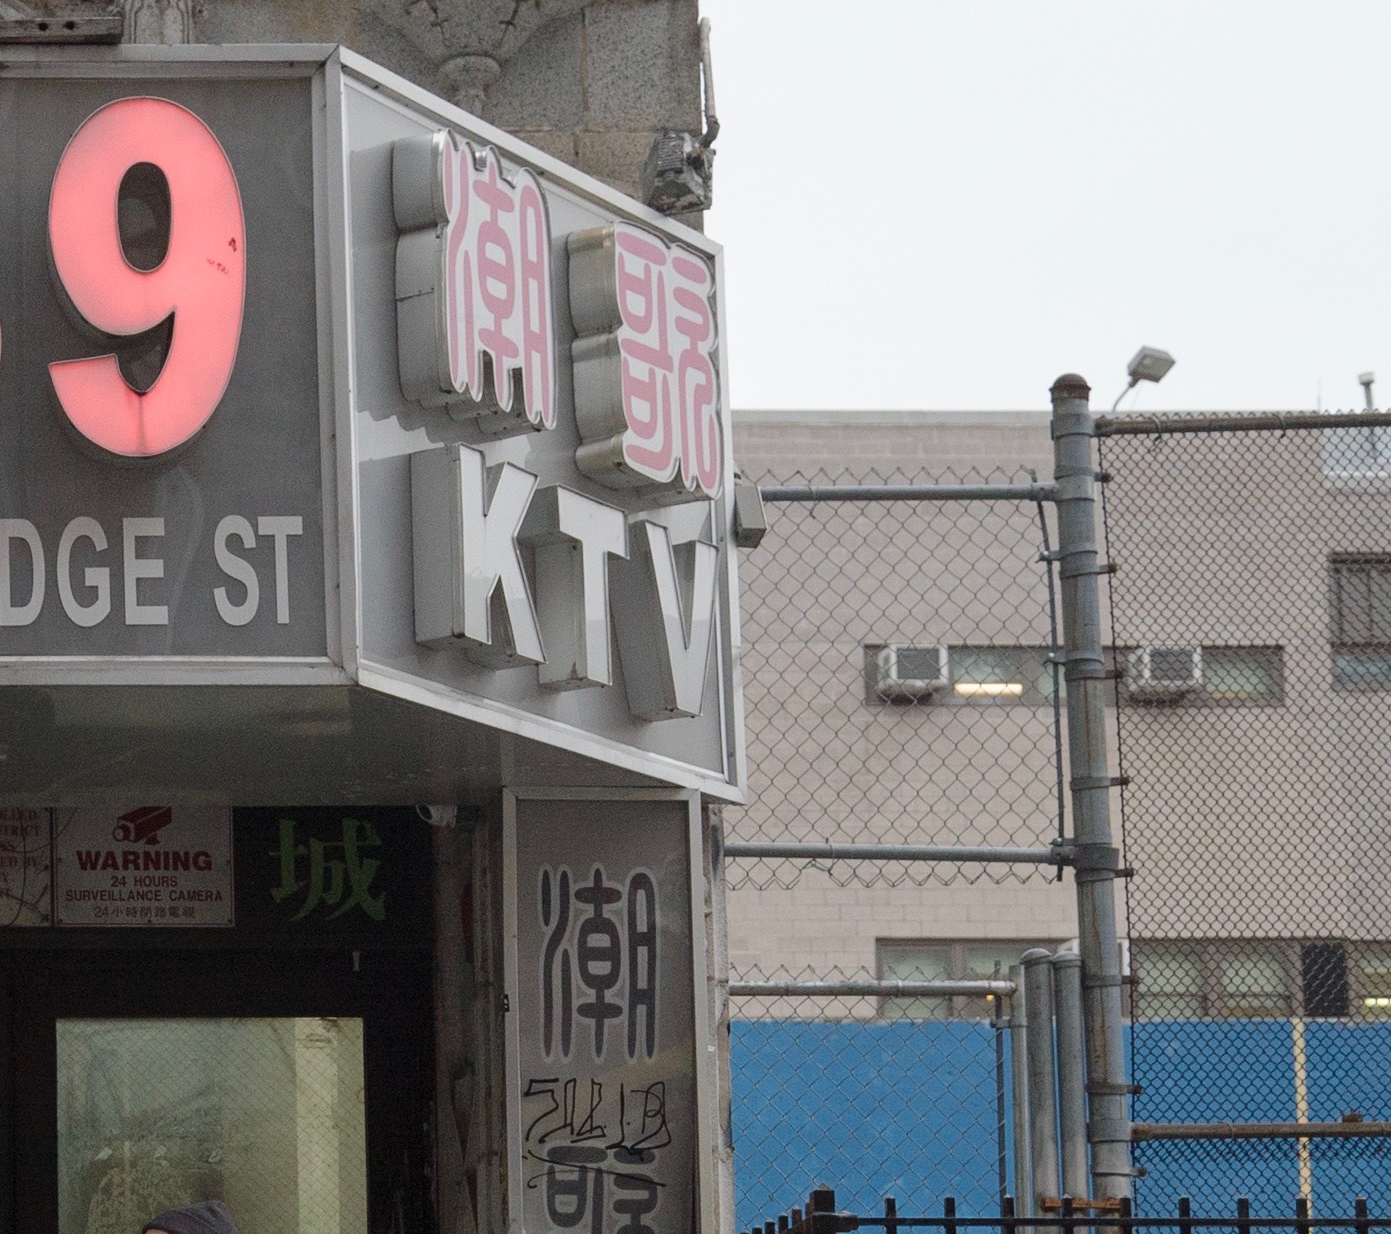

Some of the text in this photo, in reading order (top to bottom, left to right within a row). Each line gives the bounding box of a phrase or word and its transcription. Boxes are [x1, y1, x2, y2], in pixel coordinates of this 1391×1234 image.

[443, 130, 722, 499] 潮歌
[213, 516, 303, 626] ST
[457, 442, 720, 718] KTV
[23, 857, 37, 868] BY
[76, 850, 213, 871] WARNING
[111, 875, 178, 887] 24 HOURS
[65, 889, 223, 902] SURVEILLANCE CAMERA
